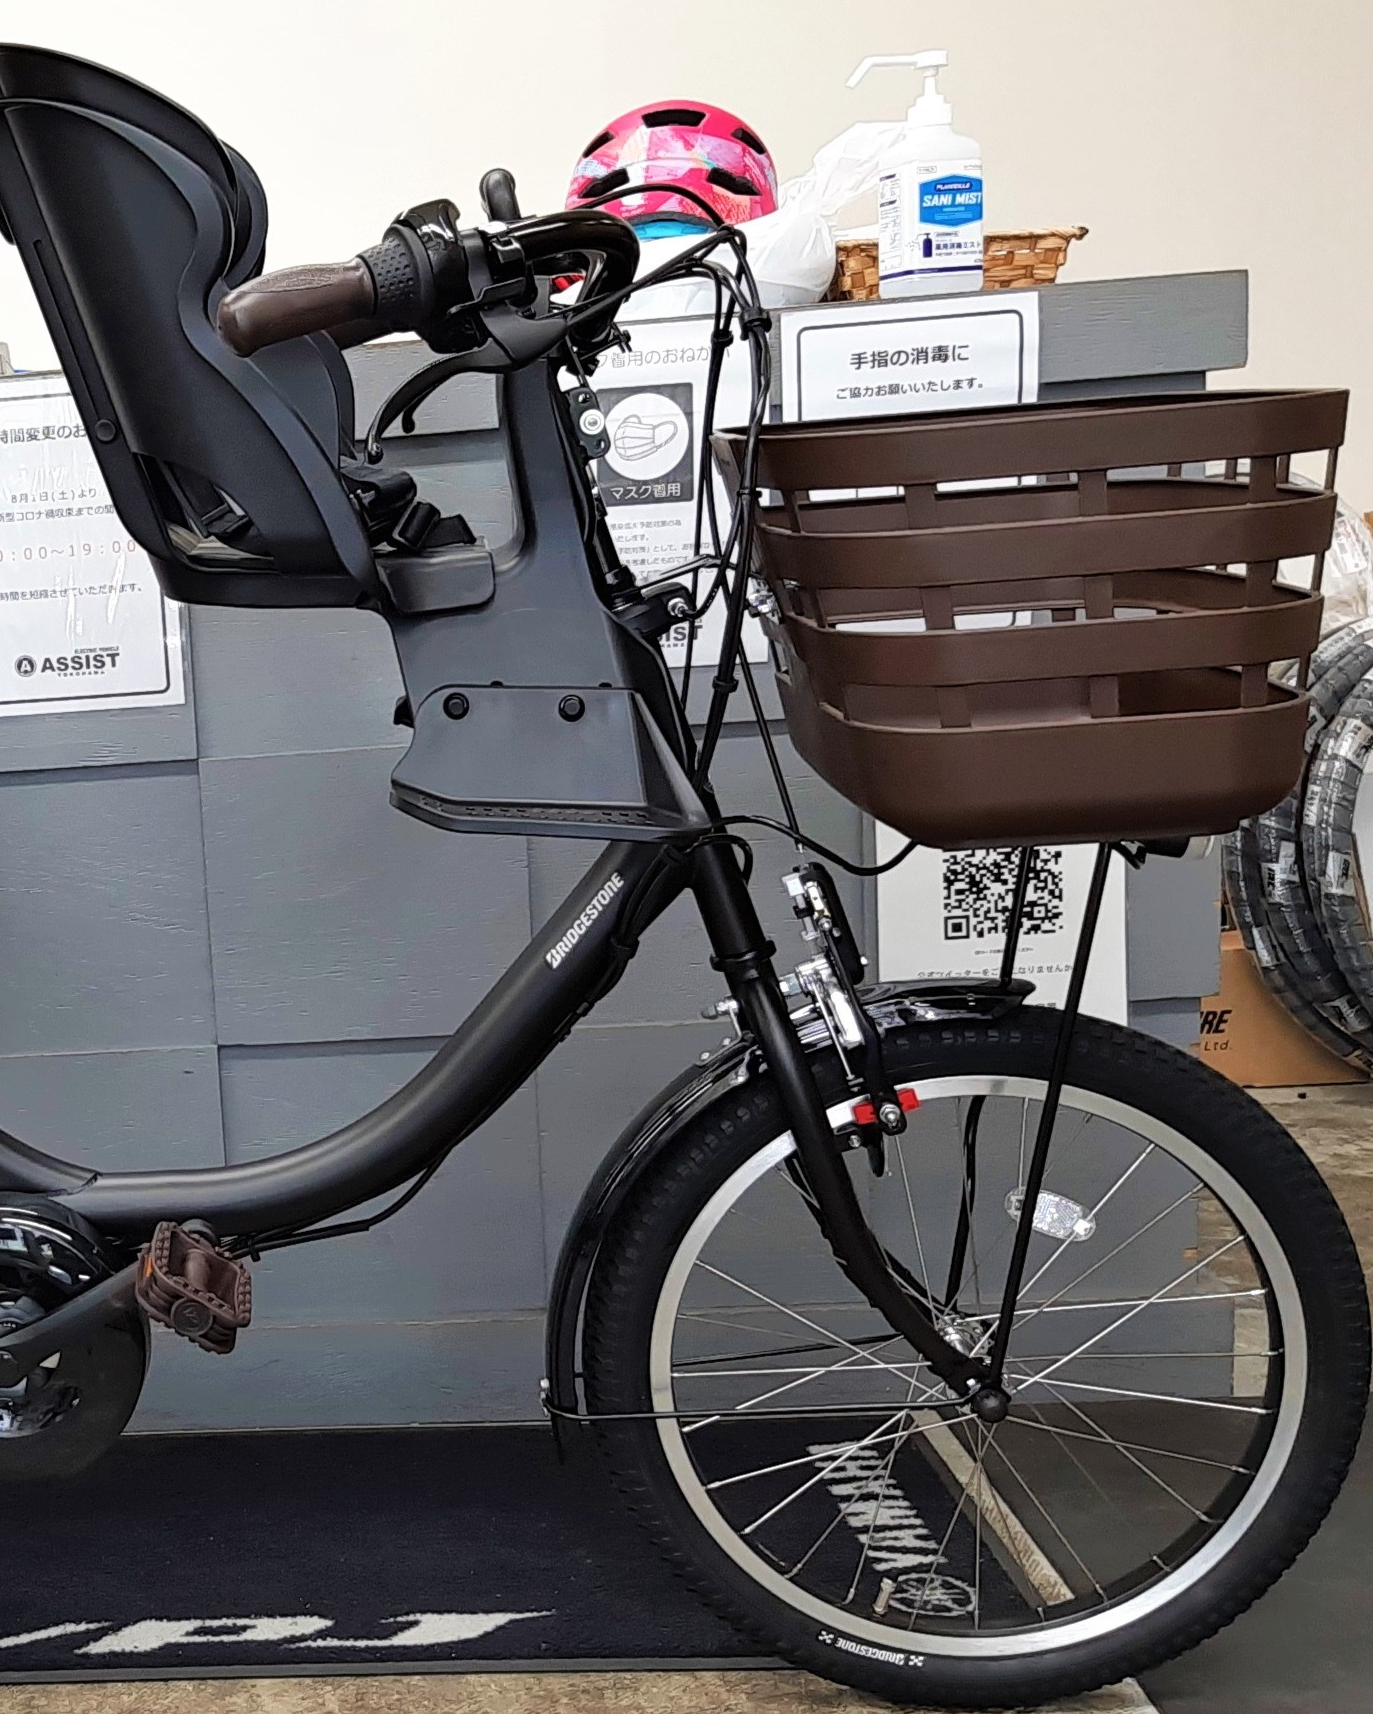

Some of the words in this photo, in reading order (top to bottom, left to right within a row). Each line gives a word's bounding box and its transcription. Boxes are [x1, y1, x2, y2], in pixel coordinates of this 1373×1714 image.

[922, 194, 953, 208] SANI
[955, 192, 982, 205] MIST
[849, 344, 970, 370] 手指の消毒に
[836, 377, 984, 400] ご協力お願いいたします。
[40, 652, 120, 673] ASSIST
[545, 871, 625, 969] BRIDGESTONE
[1200, 1010, 1233, 1034] RE
[835, 1637, 905, 1666] BRIDGESTONE
